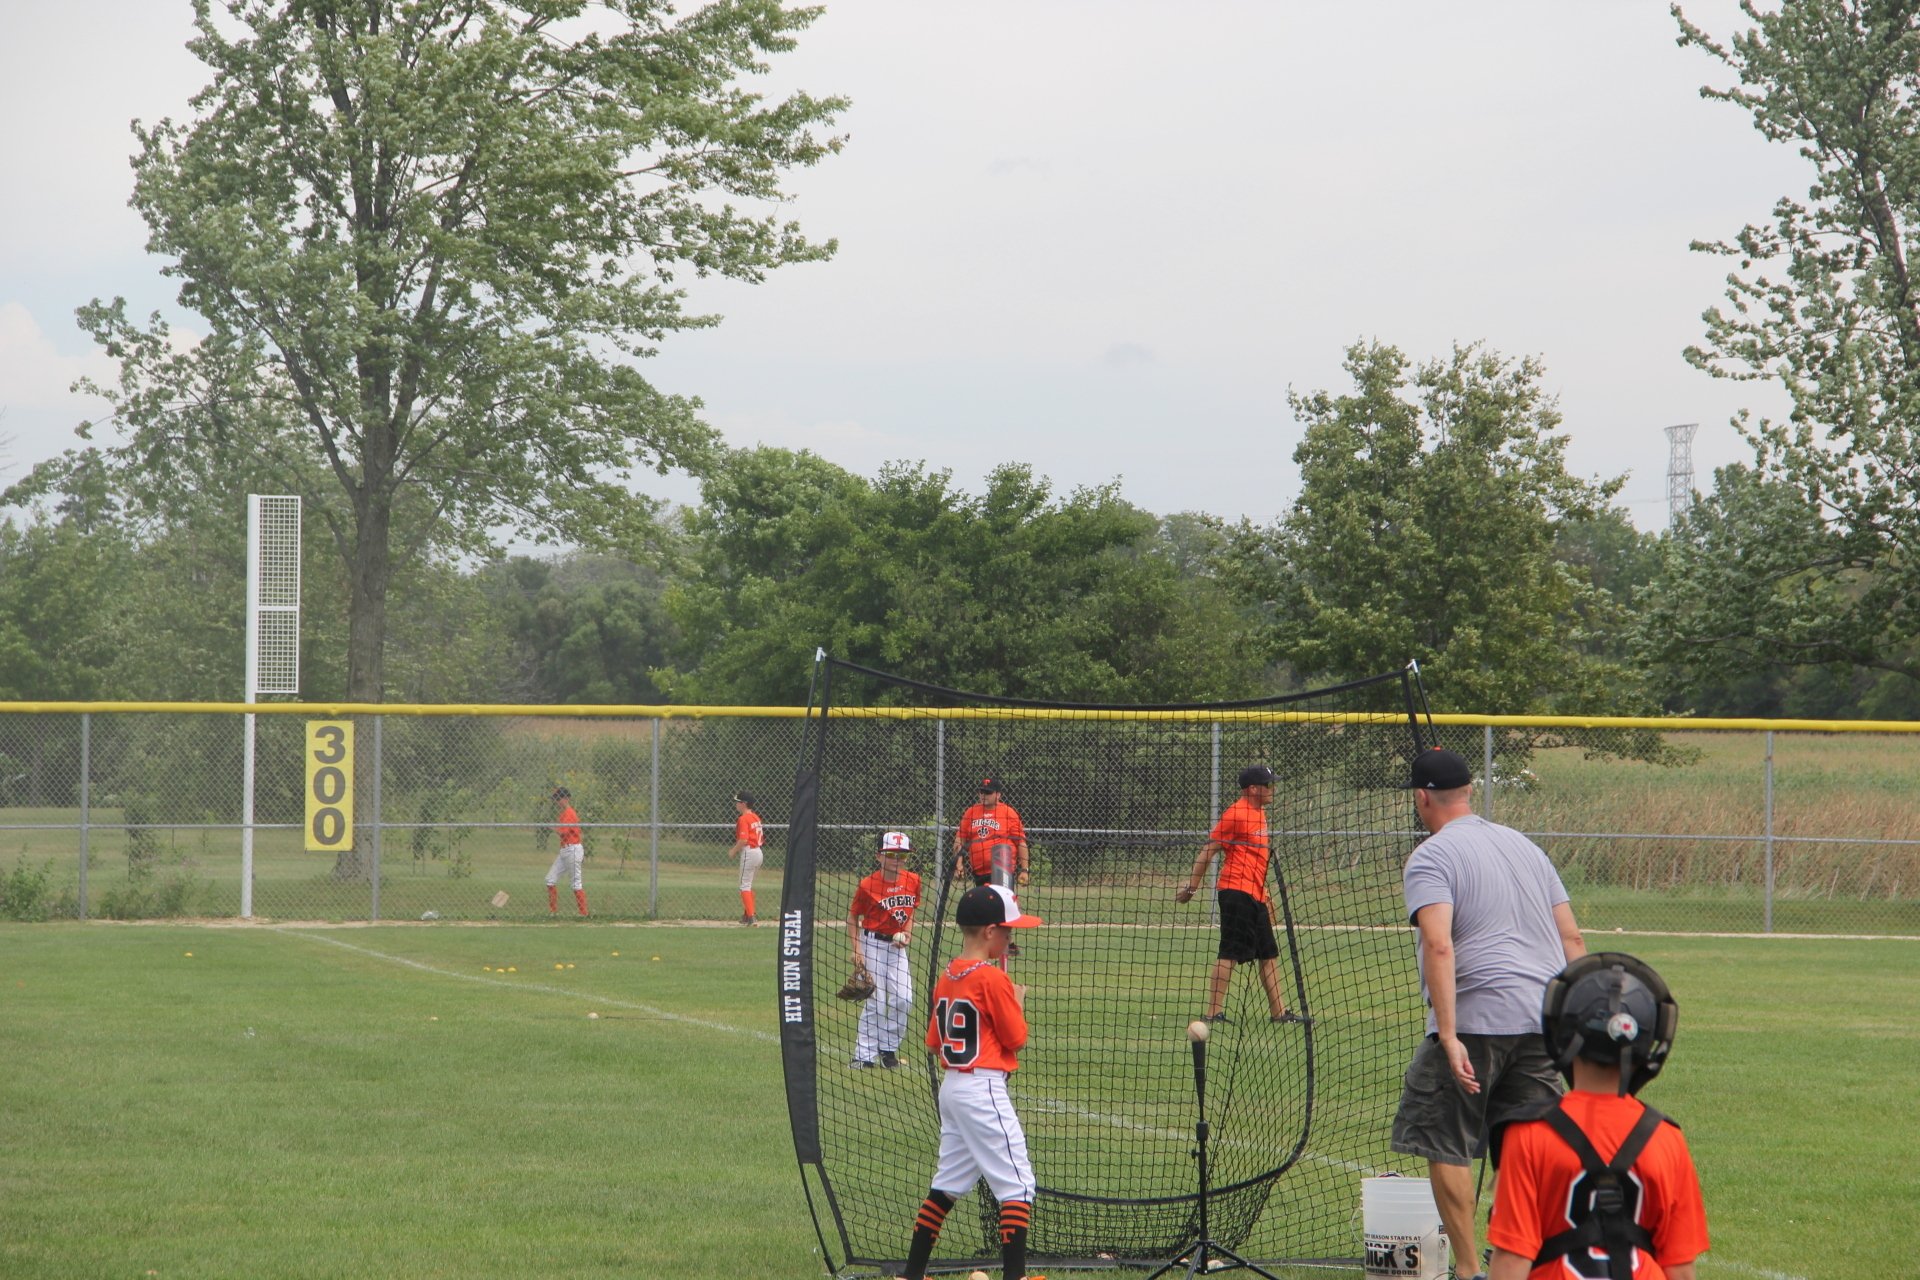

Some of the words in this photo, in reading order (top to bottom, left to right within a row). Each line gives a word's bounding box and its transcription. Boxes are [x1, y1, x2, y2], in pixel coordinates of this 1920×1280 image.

[313, 725, 346, 846] 300
[892, 835, 904, 845] T
[783, 909, 802, 956] STEAL
[783, 960, 801, 991] RUN
[784, 995, 803, 1022] HIT
[935, 997, 980, 1068] 19
